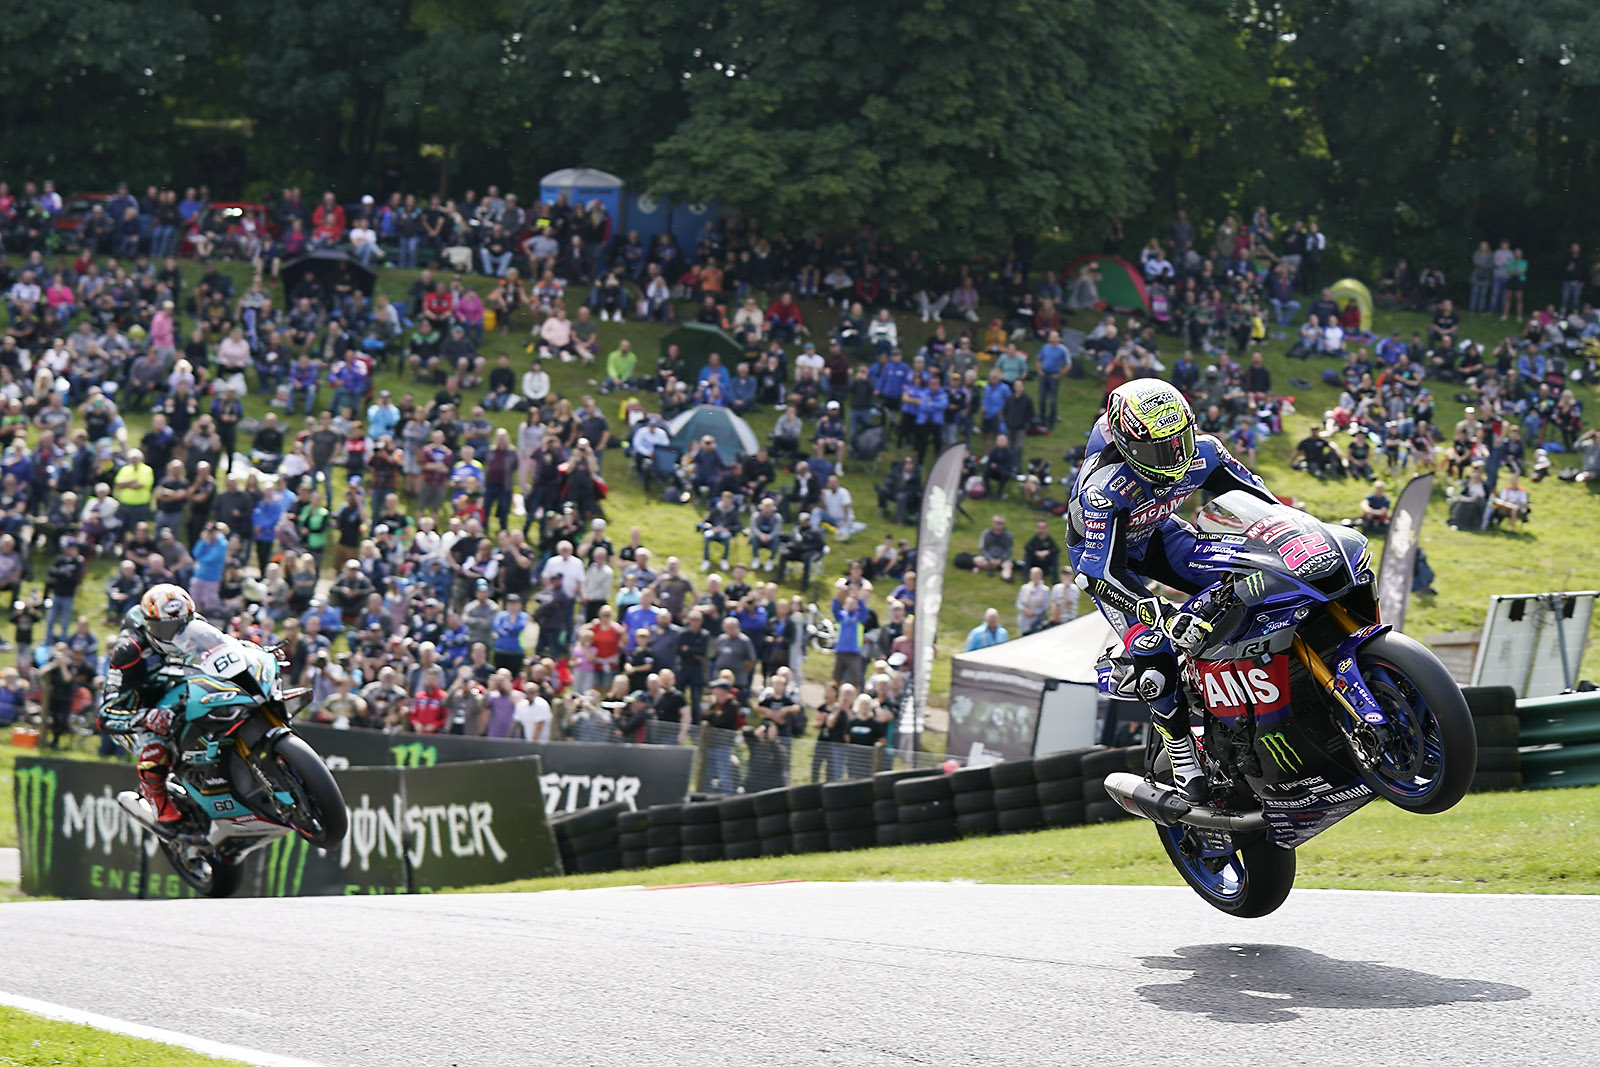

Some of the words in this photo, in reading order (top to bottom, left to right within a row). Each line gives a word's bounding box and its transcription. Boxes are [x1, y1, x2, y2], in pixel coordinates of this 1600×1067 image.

[1277, 531, 1331, 570] 22
[213, 799, 235, 812] 60
[539, 773, 641, 813] STER
[1321, 784, 1373, 804] YAMAHA
